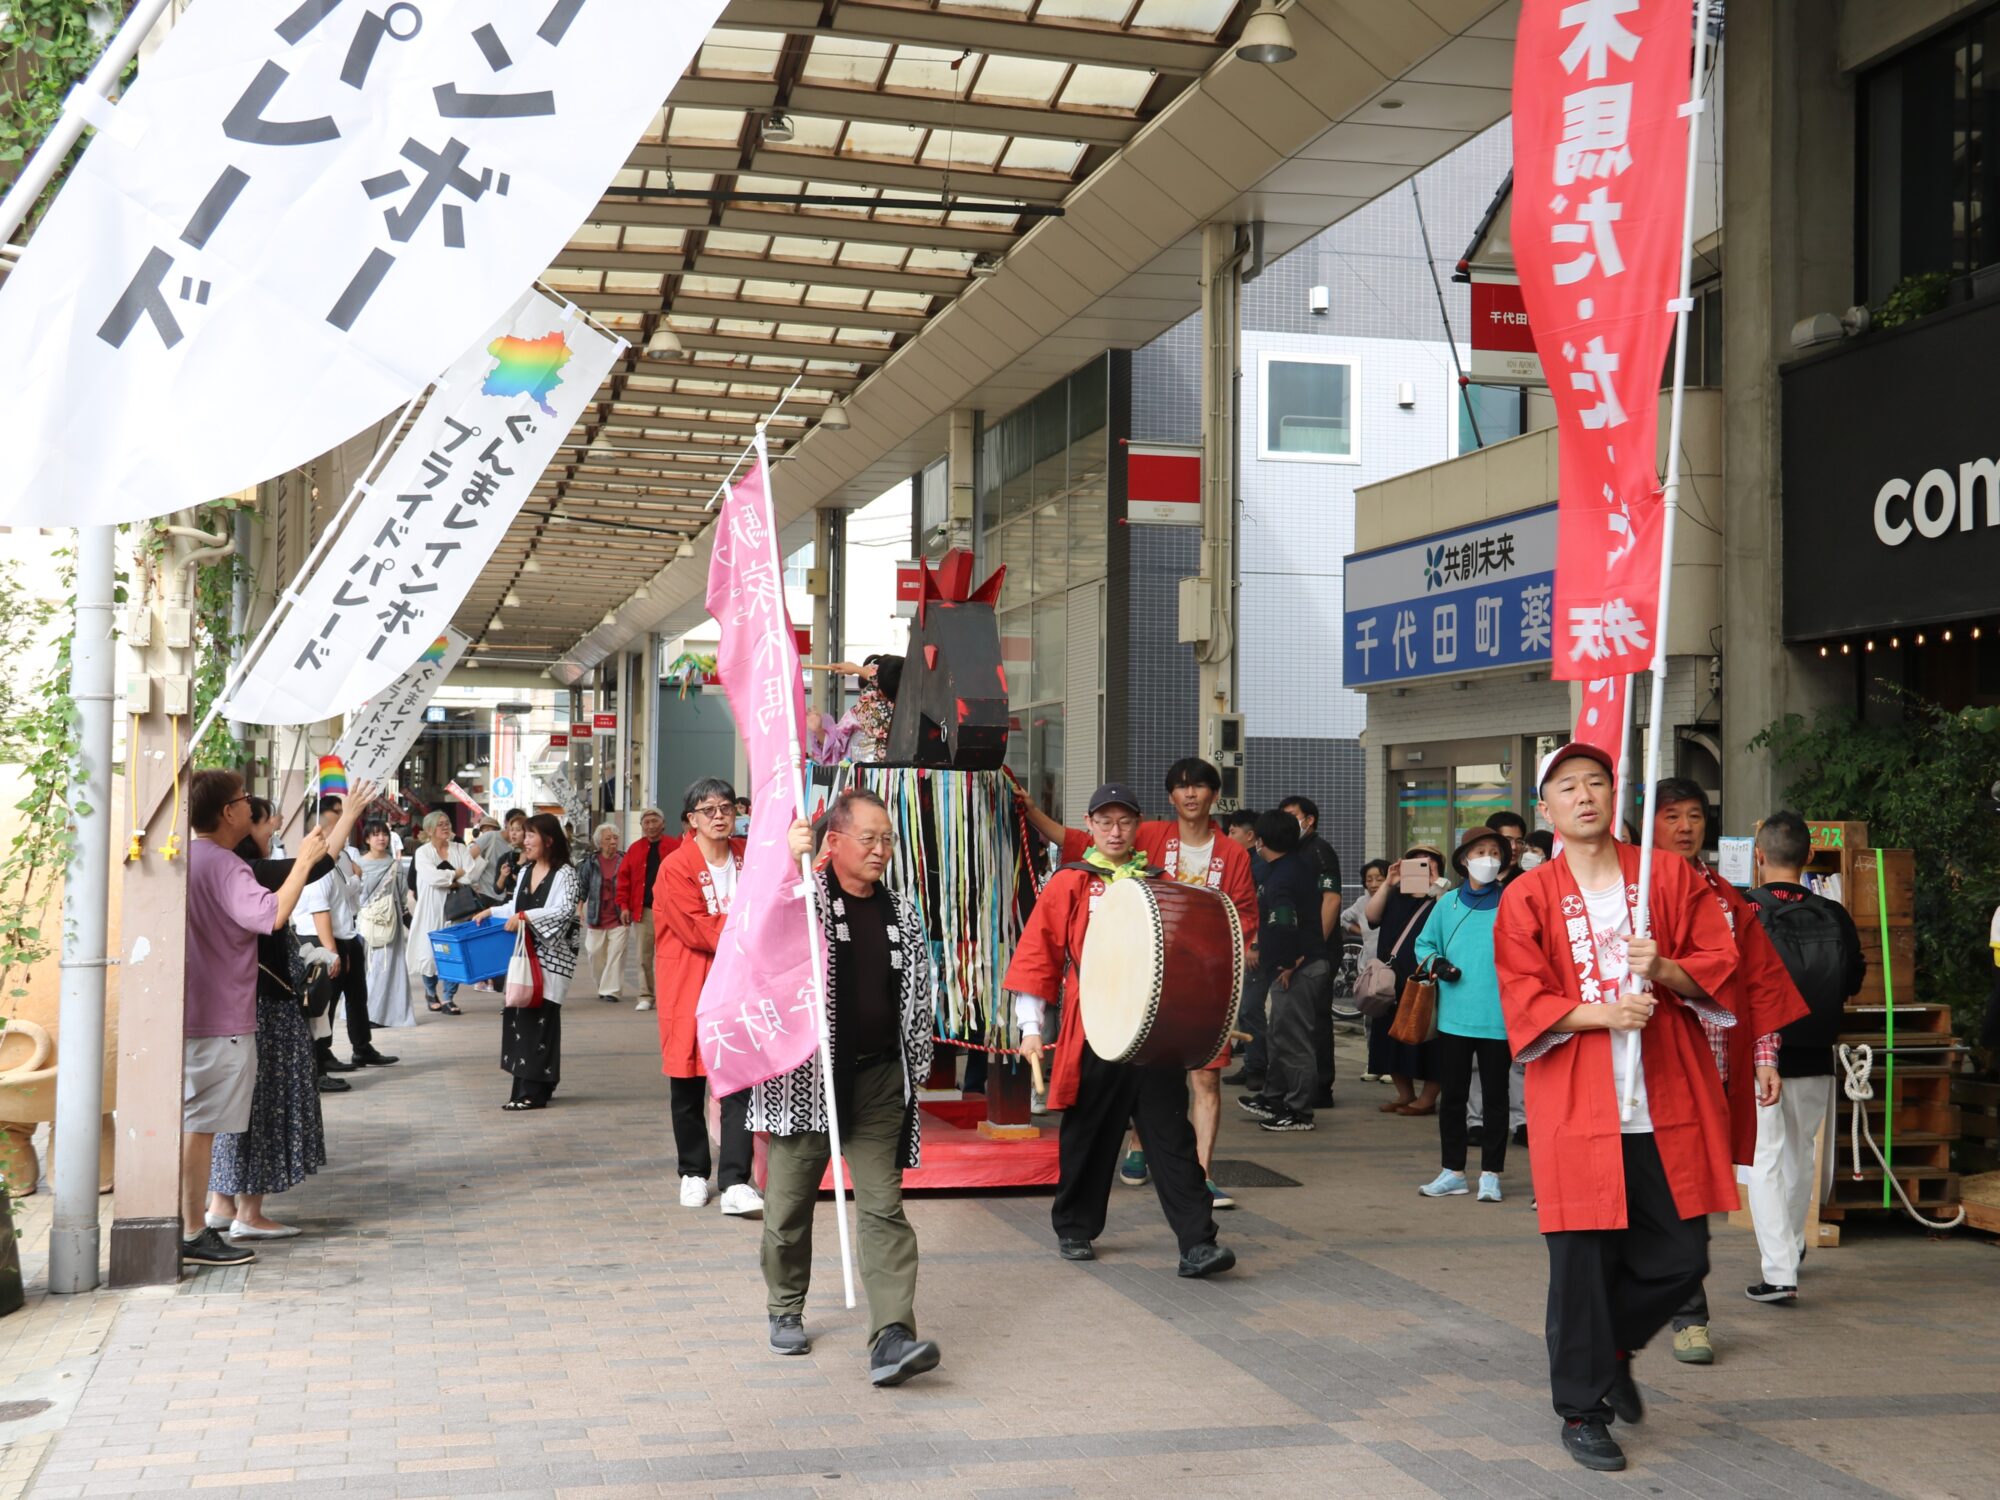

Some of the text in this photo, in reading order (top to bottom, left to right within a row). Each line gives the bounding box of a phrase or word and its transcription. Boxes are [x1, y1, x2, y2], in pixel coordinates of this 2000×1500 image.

[96, 0, 422, 350] パレード
[325, 0, 586, 333] ンボー
[294, 415, 481, 671] プライドパレード
[366, 413, 537, 661] ぐんまレインボー
[1444, 532, 1515, 584] 共創未来
[1355, 583, 1552, 676] 千代田町薬
[344, 672, 412, 773] プライドパレード
[368, 668, 435, 768] ぐんまレインボー
